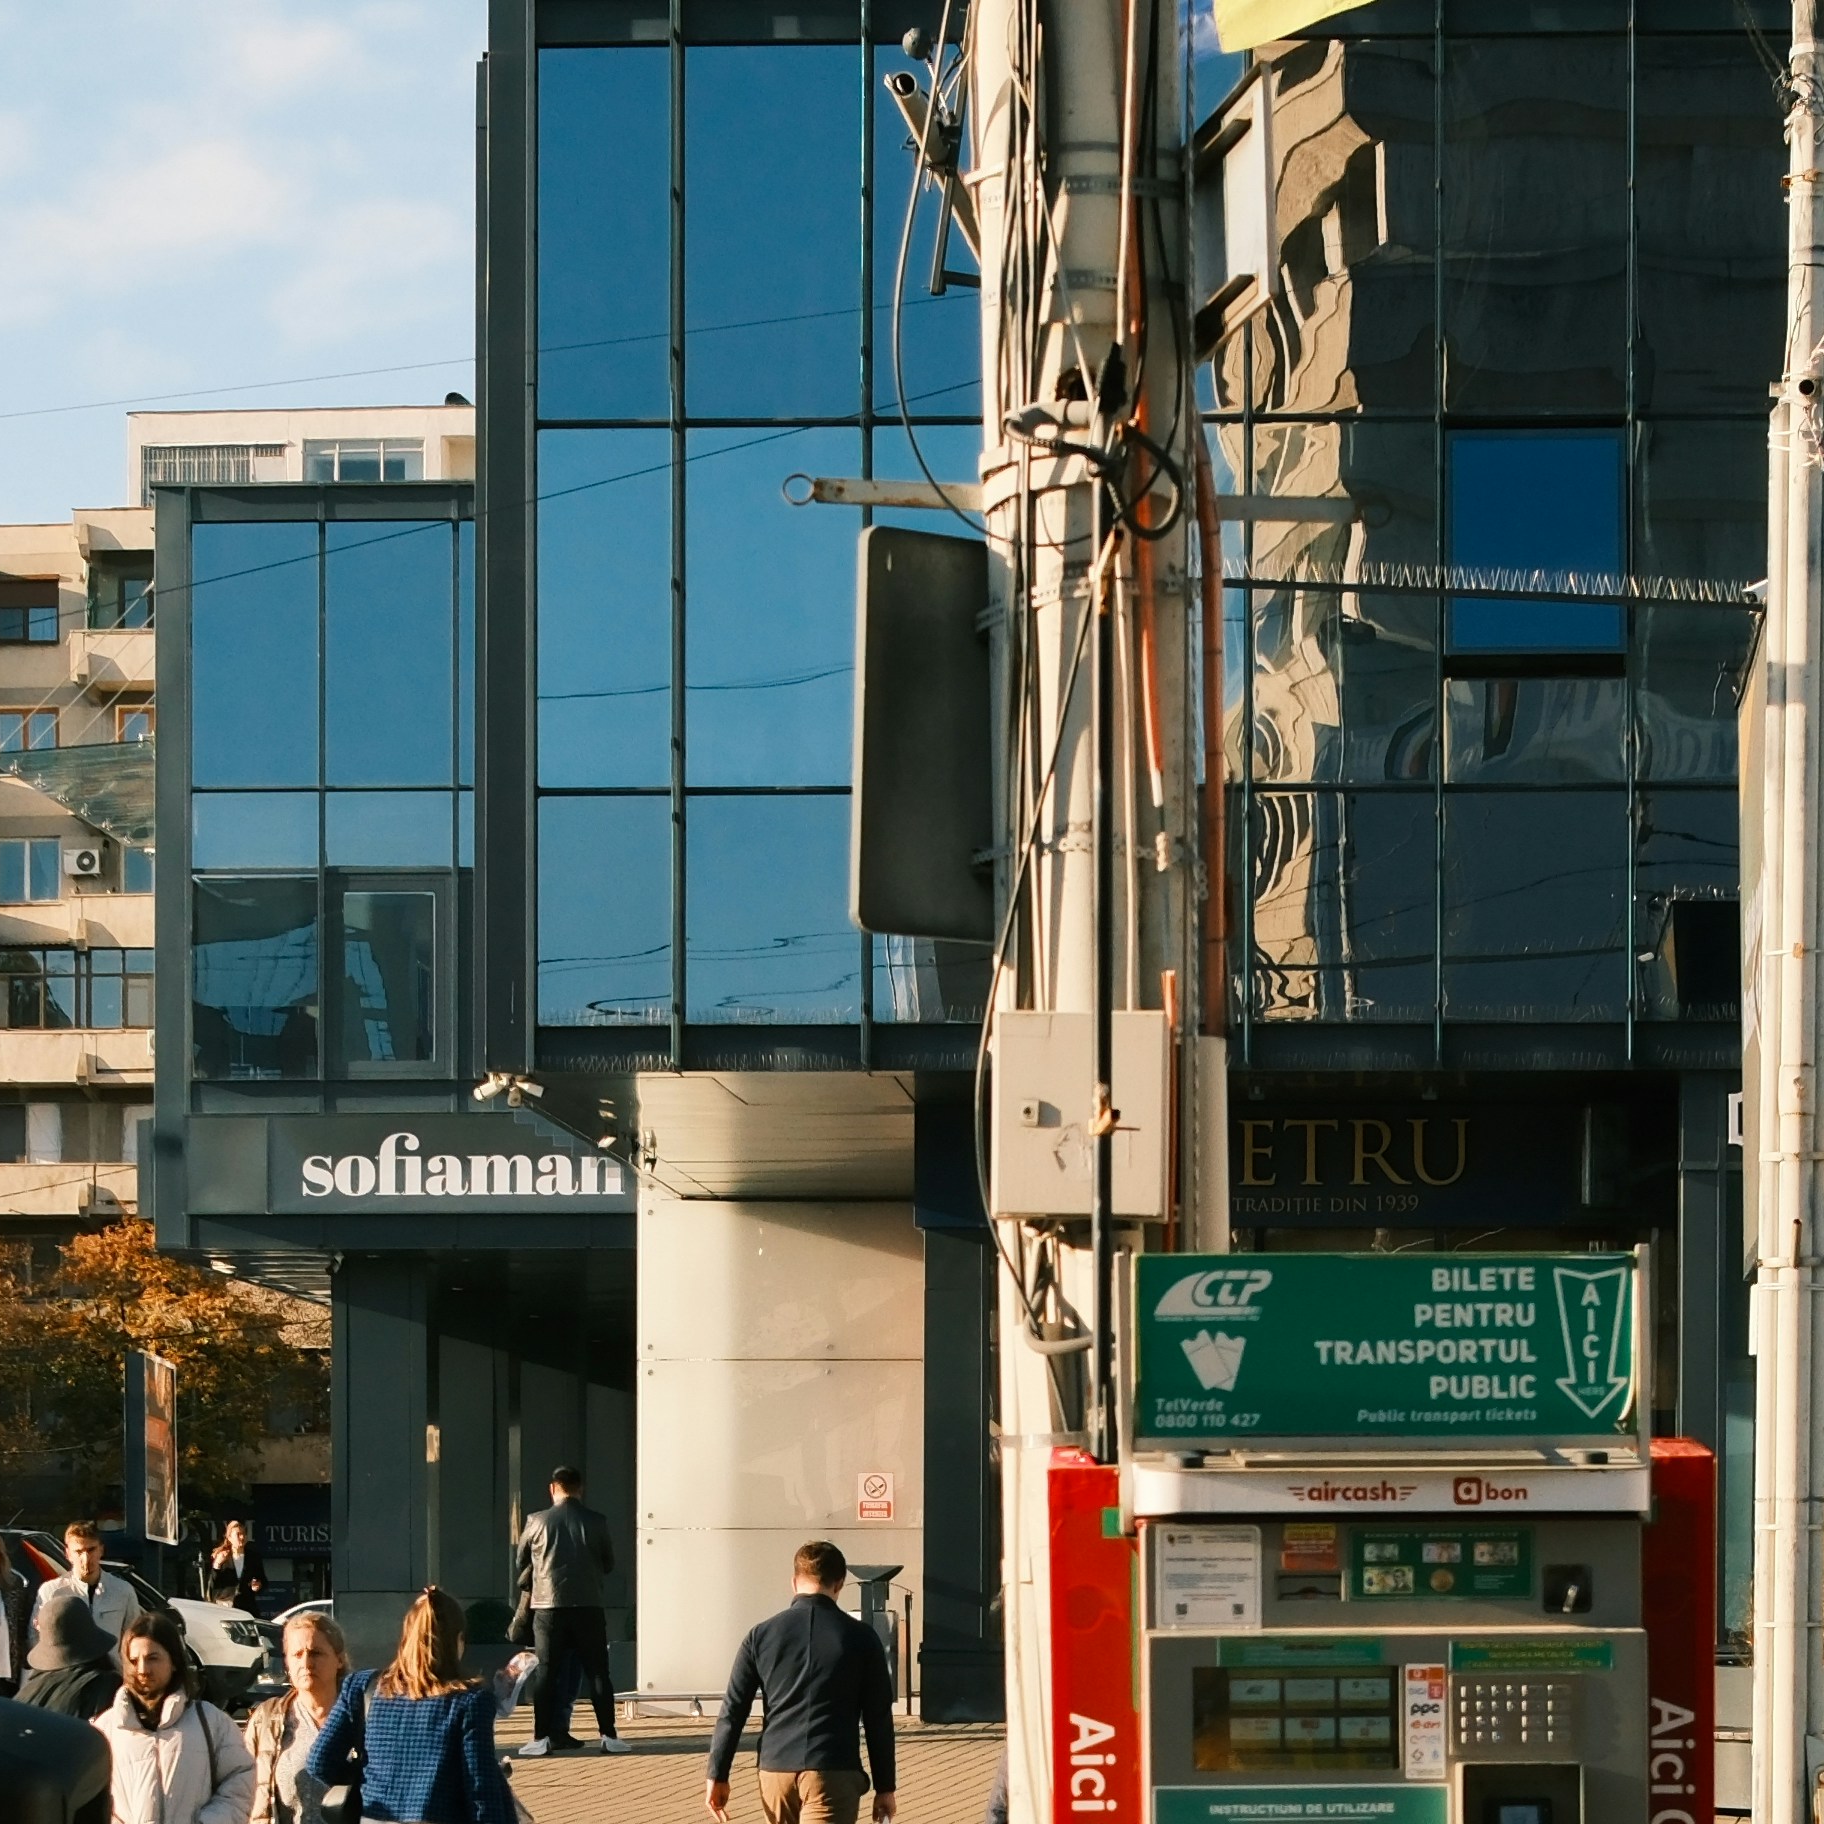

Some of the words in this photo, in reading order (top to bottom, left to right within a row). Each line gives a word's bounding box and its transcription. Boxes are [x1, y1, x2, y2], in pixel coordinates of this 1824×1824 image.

[301, 1132, 626, 1197] sofiaman
[1236, 1118, 1471, 1187] ETRU
[1330, 1197, 1367, 1213] DIN
[1376, 1195, 1420, 1213] 1939
[1431, 1267, 1536, 1292] BILETE
[1414, 1303, 1537, 1328] PENTRU
[1580, 1282, 1601, 1384] AICI
[1314, 1339, 1538, 1365] TRANSPORTUL
[1430, 1375, 1538, 1400] PUBLIC
[1154, 1414, 1198, 1428] 0800
[1202, 1414, 1226, 1427] 110
[1231, 1413, 1262, 1427] 427
[1357, 1409, 1406, 1423] Public
[1410, 1408, 1482, 1424] transport
[1485, 1407, 1537, 1422] tickets
[1307, 1480, 1397, 1501] aircash
[265, 1524, 333, 1543] TURIS
[1410, 1703, 1440, 1717] ppc
[1650, 1703, 1697, 1796] Aici
[1069, 1712, 1117, 1813] Aici
[1209, 1804, 1302, 1817] INSTRUCȚIUNI
[1306, 1803, 1324, 1814] DE
[1327, 1802, 1396, 1814] UTILIZARE
